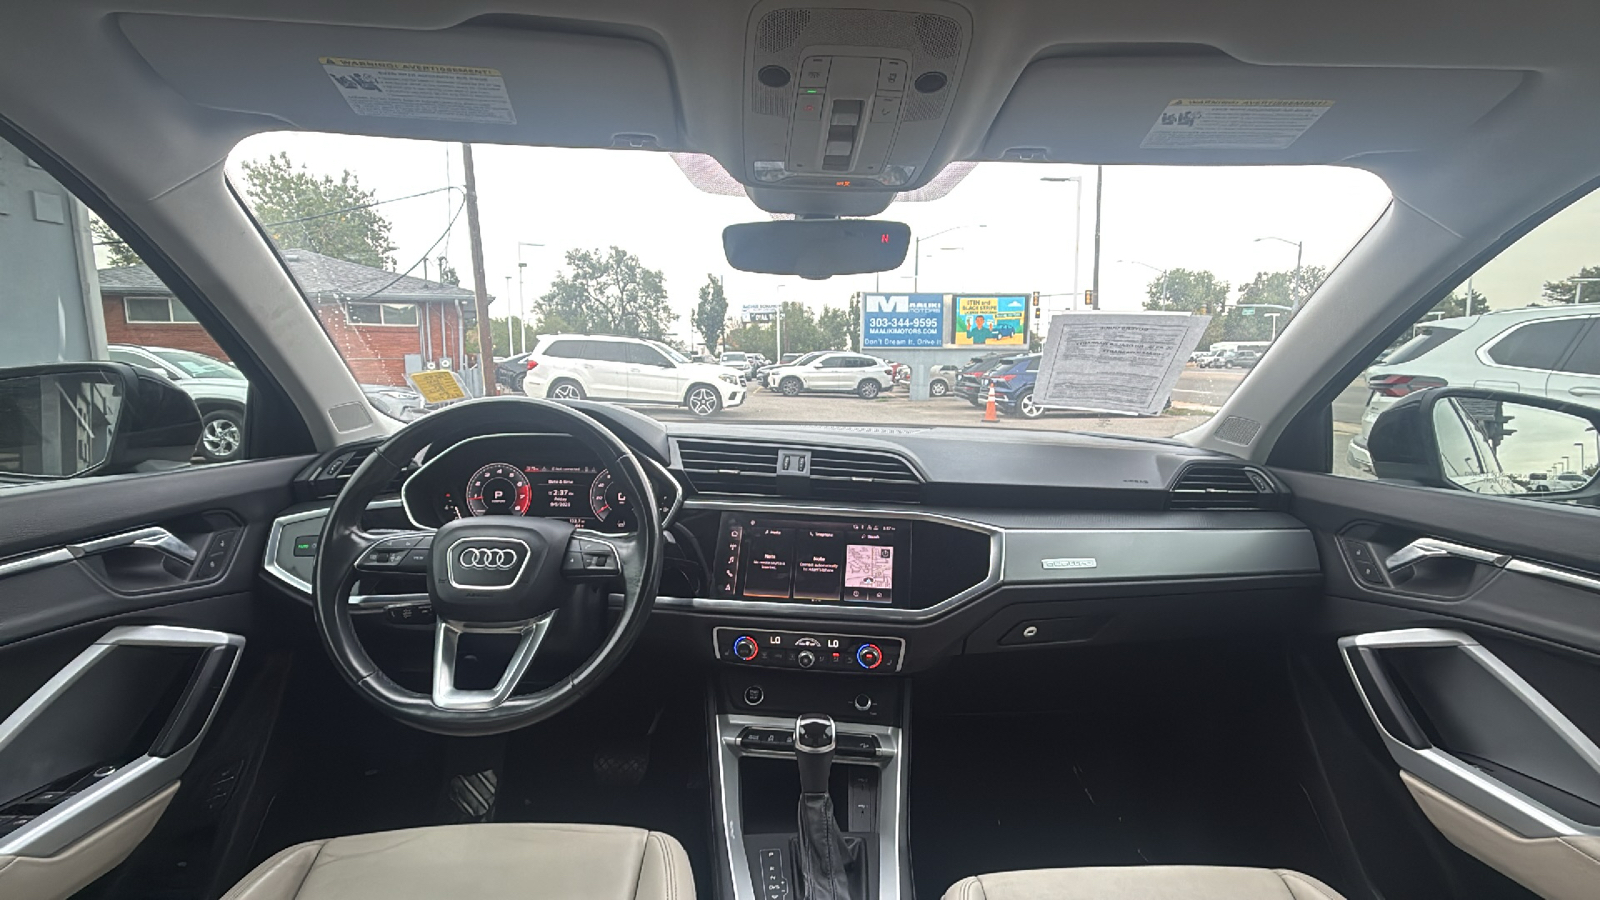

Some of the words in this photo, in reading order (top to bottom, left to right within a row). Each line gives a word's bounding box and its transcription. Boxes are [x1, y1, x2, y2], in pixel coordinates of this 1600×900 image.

[341, 60, 399, 69] WARNING!
[881, 234, 890, 244] N
[869, 318, 938, 328] 303-344-9595
[864, 338, 883, 346] Don't
[884, 338, 907, 346] Dream
[916, 338, 936, 346] Drive
[494, 490, 504, 499] P
